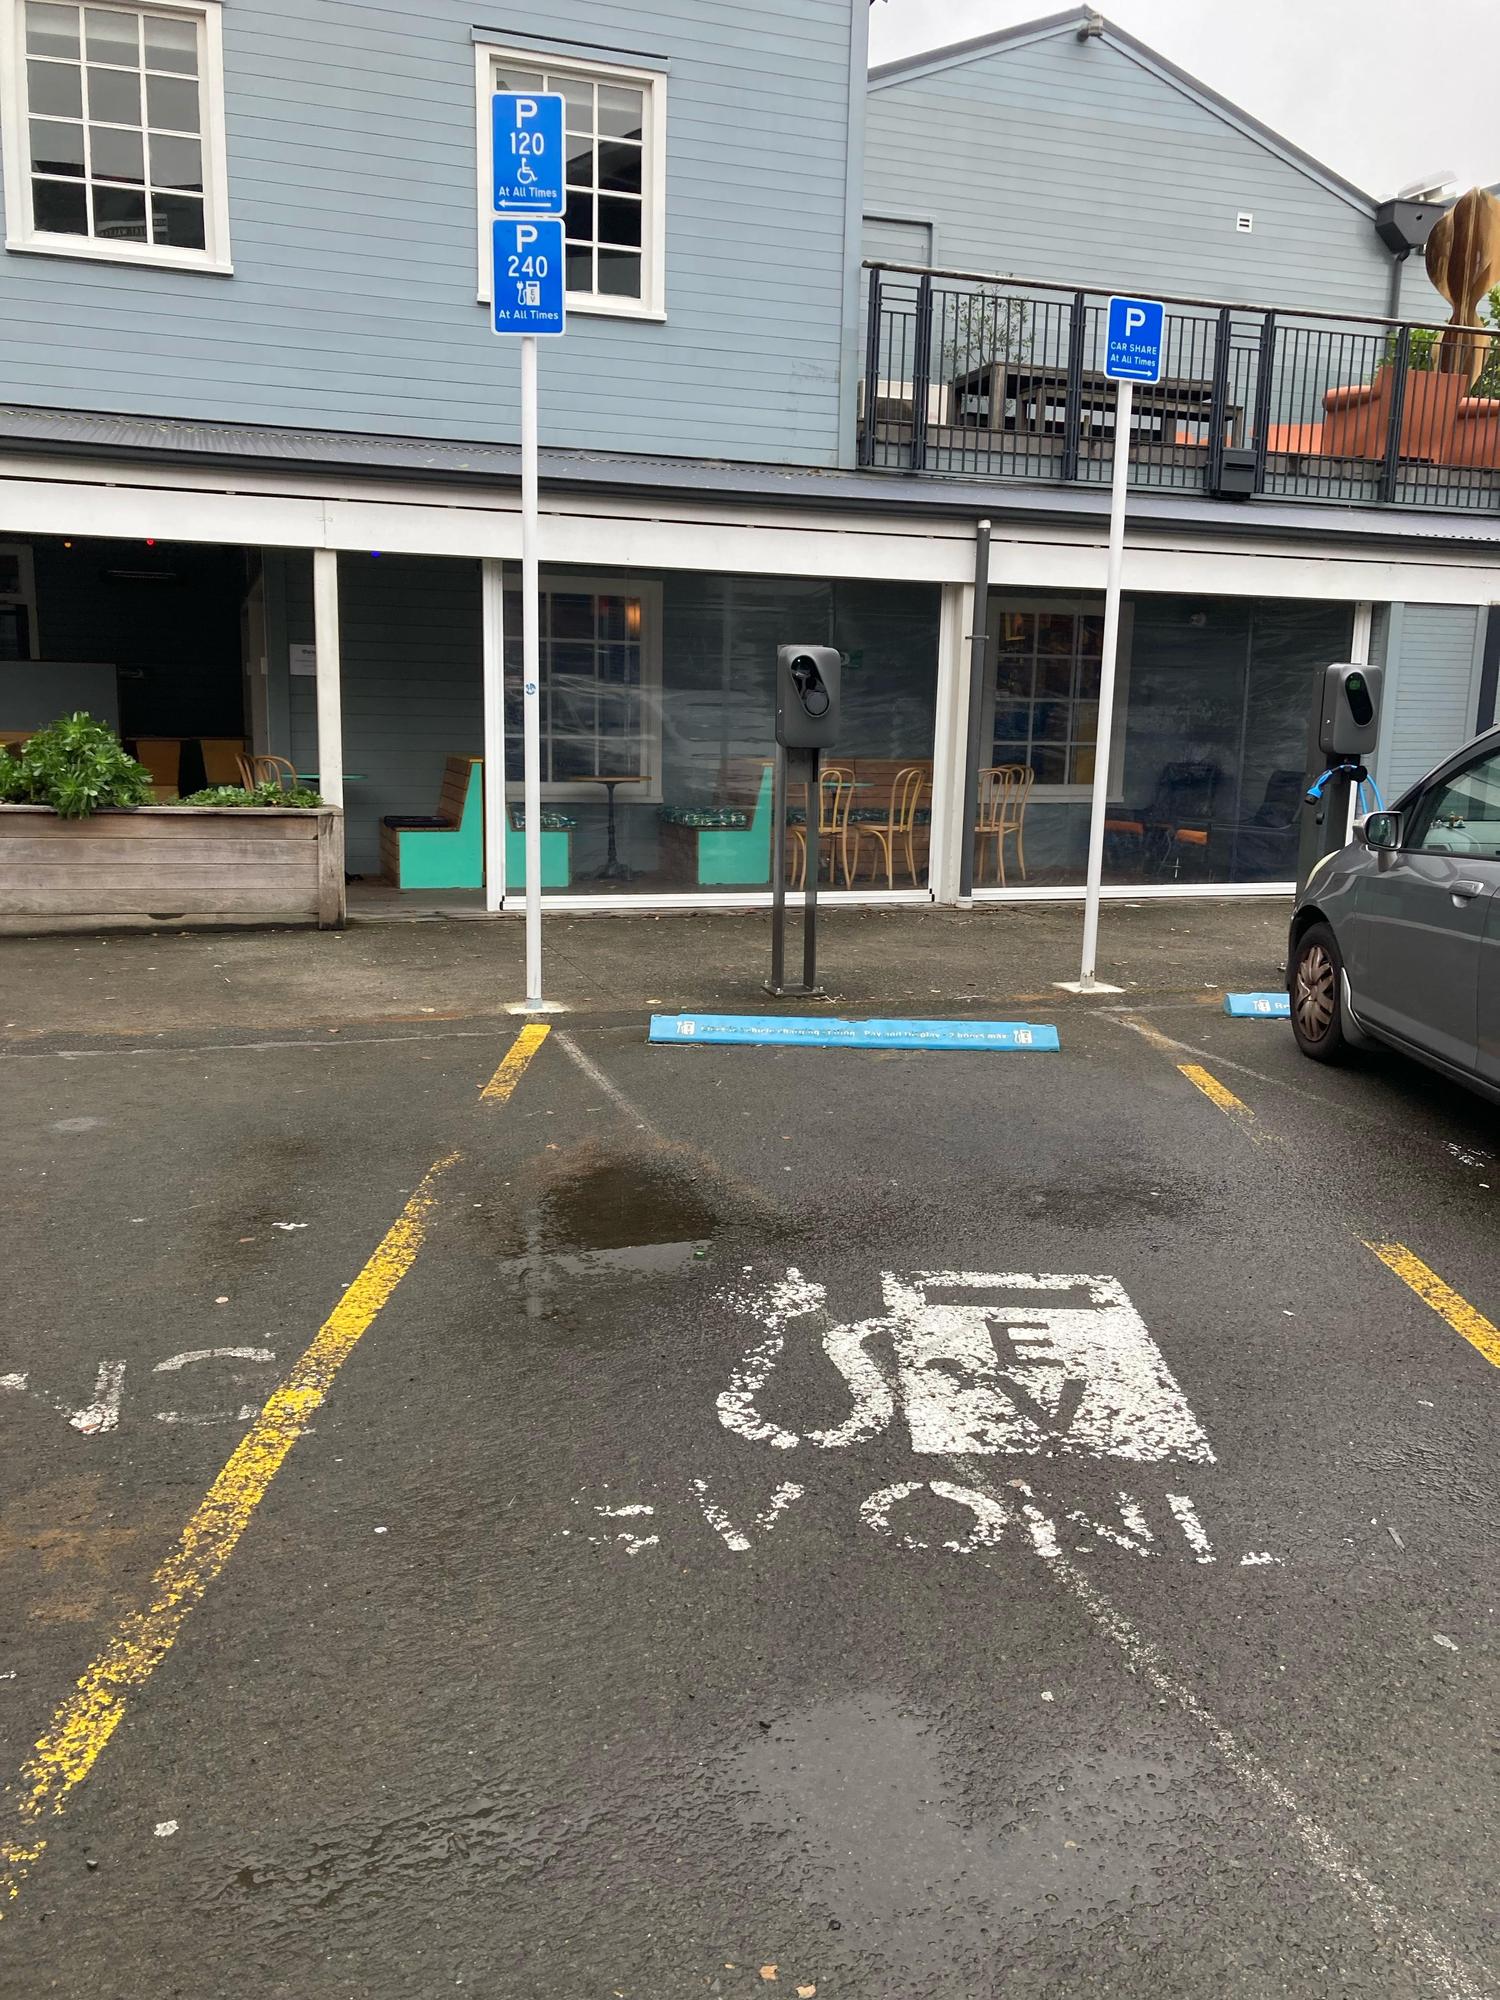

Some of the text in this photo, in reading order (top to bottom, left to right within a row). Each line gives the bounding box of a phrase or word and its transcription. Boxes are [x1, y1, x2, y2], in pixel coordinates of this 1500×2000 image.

[516, 99, 538, 128] P
[510, 132, 544, 155] 120
[499, 186, 557, 198] At All Times
[516, 224, 538, 253] P
[507, 255, 548, 278] 240
[499, 310, 559, 320] At All Times
[1125, 307, 1146, 336] P
[1110, 341, 1157, 355] CAR SHARE
[1110, 354, 1156, 367] At All Times
[984, 1317, 1088, 1437] EV
